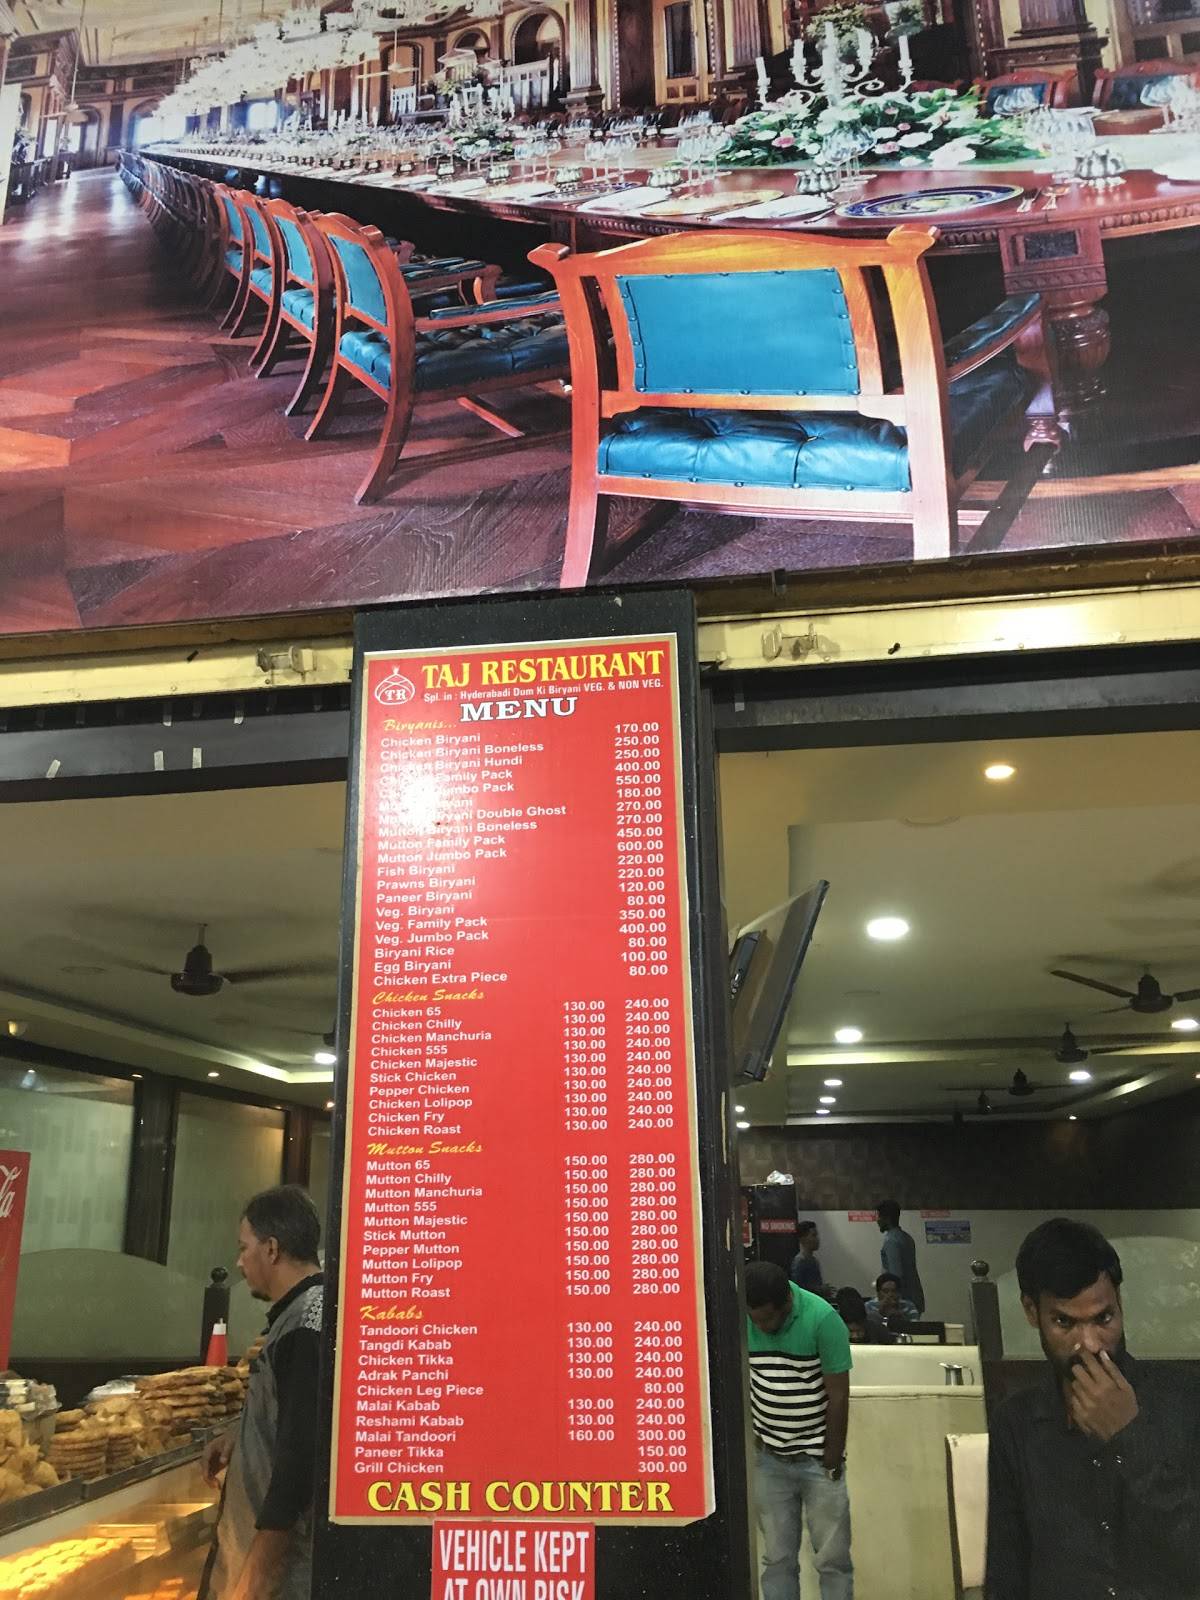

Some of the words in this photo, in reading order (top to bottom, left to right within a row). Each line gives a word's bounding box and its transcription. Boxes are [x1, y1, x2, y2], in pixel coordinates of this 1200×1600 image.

[422, 663, 470, 689] TAJ
[482, 650, 664, 685] RESTAURANT
[424, 692, 441, 702] Spl.
[444, 692, 453, 700] in
[460, 688, 511, 701] Hyderabadi
[513, 687, 534, 696] Dum
[536, 686, 546, 695] Ki
[548, 684, 582, 696] Biryani
[583, 682, 605, 692] VEG.
[608, 682, 616, 691] &
[618, 680, 640, 690] NON
[642, 678, 664, 688] VEG.
[459, 697, 579, 722] MENU
[435, 732, 481, 746] Biryani
[614, 722, 659, 733] 170.00
[435, 745, 481, 759] Biryani
[484, 741, 544, 754] Boneless
[614, 735, 659, 747] 250.00
[473, 834, 506, 845] Pack
[616, 826, 663, 838] 450.00
[377, 851, 423, 863] Mutton
[475, 847, 507, 859] Pack
[617, 840, 663, 851] 600.00
[377, 867, 404, 876] Fish
[410, 866, 454, 877] Biryani
[617, 853, 663, 865] 220.00
[377, 880, 425, 890] Prawns
[429, 877, 475, 888] Biryani
[618, 867, 664, 879] 220.00
[376, 893, 422, 903] Paneer
[426, 890, 472, 902] Biryani
[618, 881, 664, 892] 120.00
[376, 907, 403, 919] Veg.
[408, 906, 454, 917] Biryani
[627, 894, 665, 905] 80.00
[374, 934, 403, 946] Veg.
[407, 932, 452, 943] Jumbo
[456, 930, 488, 941] Pack
[619, 922, 666, 934] 400.00
[375, 947, 421, 960] Biryani
[425, 946, 455, 956] Rice
[628, 936, 667, 948] 80.00
[374, 962, 400, 974] Egg
[404, 959, 451, 973] Biryani
[621, 950, 667, 962] 100.00
[373, 975, 427, 986] Chicken
[432, 973, 467, 984] Extra
[471, 972, 508, 982] Piece
[629, 964, 668, 976] 80.00
[372, 991, 428, 1005] Chicken
[432, 988, 484, 1001] Snacks
[372, 1008, 423, 1018] Chicken
[426, 1006, 441, 1016] 65
[563, 1000, 605, 1011] 130.00
[625, 998, 669, 1009] 240.00
[371, 1021, 422, 1031] Chicken
[426, 1019, 462, 1030] Chilly
[563, 1013, 605, 1024] 130.00
[625, 1011, 670, 1022] 240.00
[371, 1033, 422, 1044] Chicken
[426, 1031, 491, 1042] Manchuria
[563, 1026, 605, 1037] 130.00
[625, 1024, 670, 1035] 240.00
[370, 1059, 421, 1070] Chicken
[425, 1057, 477, 1070] Majestic
[564, 1052, 606, 1063] 130.00
[626, 1050, 671, 1061] 240.00
[370, 1073, 401, 1083] Stick
[405, 1071, 456, 1082] Chicken
[564, 1065, 606, 1076] 130.00
[627, 1064, 671, 1075] 240.00
[368, 1099, 420, 1109] Chicken
[424, 1097, 472, 1109] Lolipop
[564, 1092, 607, 1103] 130.00
[627, 1090, 672, 1101] 240.00
[367, 1125, 419, 1136] Chicken
[423, 1124, 461, 1134] Roast
[564, 1119, 607, 1130] 130.00
[628, 1117, 673, 1129] 240.00
[367, 1143, 424, 1155] Mutton
[428, 1141, 482, 1154] Snacks
[366, 1161, 411, 1171] Mutton
[415, 1160, 430, 1170] 65
[564, 1155, 607, 1166] 150.00
[629, 1153, 675, 1164] 280.00
[366, 1175, 410, 1185] Mutton
[414, 1173, 452, 1185] Chilly
[564, 1169, 608, 1180] 150.00
[629, 1167, 675, 1178] 280.00
[364, 1202, 410, 1212] Mutton
[414, 1201, 437, 1212] 555
[565, 1197, 608, 1208] 150.00
[630, 1195, 676, 1207] 280.00
[364, 1216, 409, 1227] Mutton
[413, 1215, 467, 1228] Majestic
[564, 1211, 609, 1222] 150.00
[631, 1210, 677, 1221] 280.00
[362, 1259, 408, 1269] Mutton
[412, 1258, 462, 1270] Lolipop
[565, 1254, 610, 1266] 150.00
[632, 1253, 679, 1265] 280.00
[361, 1288, 407, 1298] Mutton
[411, 1287, 450, 1298] Roast
[566, 1284, 610, 1295] 150.00
[633, 1283, 680, 1294] 280.00
[359, 1305, 422, 1320] Kababs
[360, 1324, 418, 1336] Tandoori
[422, 1324, 477, 1335] Chicken
[567, 1321, 612, 1333] 130.00
[634, 1320, 682, 1332] 240.00
[358, 1355, 413, 1366] Chicken
[417, 1354, 453, 1365] Tikka
[568, 1352, 613, 1363] 130.00
[634, 1351, 683, 1363] 240.00
[357, 1370, 398, 1381] Adrak
[402, 1369, 448, 1380] Panchi
[567, 1367, 613, 1379] 130.00
[635, 1366, 683, 1378] 240.00
[357, 1385, 412, 1396] Chicken
[416, 1385, 442, 1398] Leg
[446, 1384, 484, 1395] Piece
[644, 1382, 684, 1394] 80.00
[355, 1431, 391, 1442] Malai
[395, 1430, 456, 1442] Tandoori
[568, 1429, 614, 1441] 160.00
[637, 1429, 686, 1441] 300.00
[354, 1446, 403, 1458] Paneer
[407, 1446, 444, 1457] Tikka
[638, 1445, 686, 1457] 150.00
[354, 1462, 383, 1473] Grill
[387, 1462, 443, 1473] Chicken
[638, 1461, 687, 1473] 300.00
[366, 1480, 472, 1512] CASH
[484, 1480, 674, 1512] COUNTER
[439, 1529, 527, 1572] VEHICLE
[534, 1531, 590, 1573] KEPT
